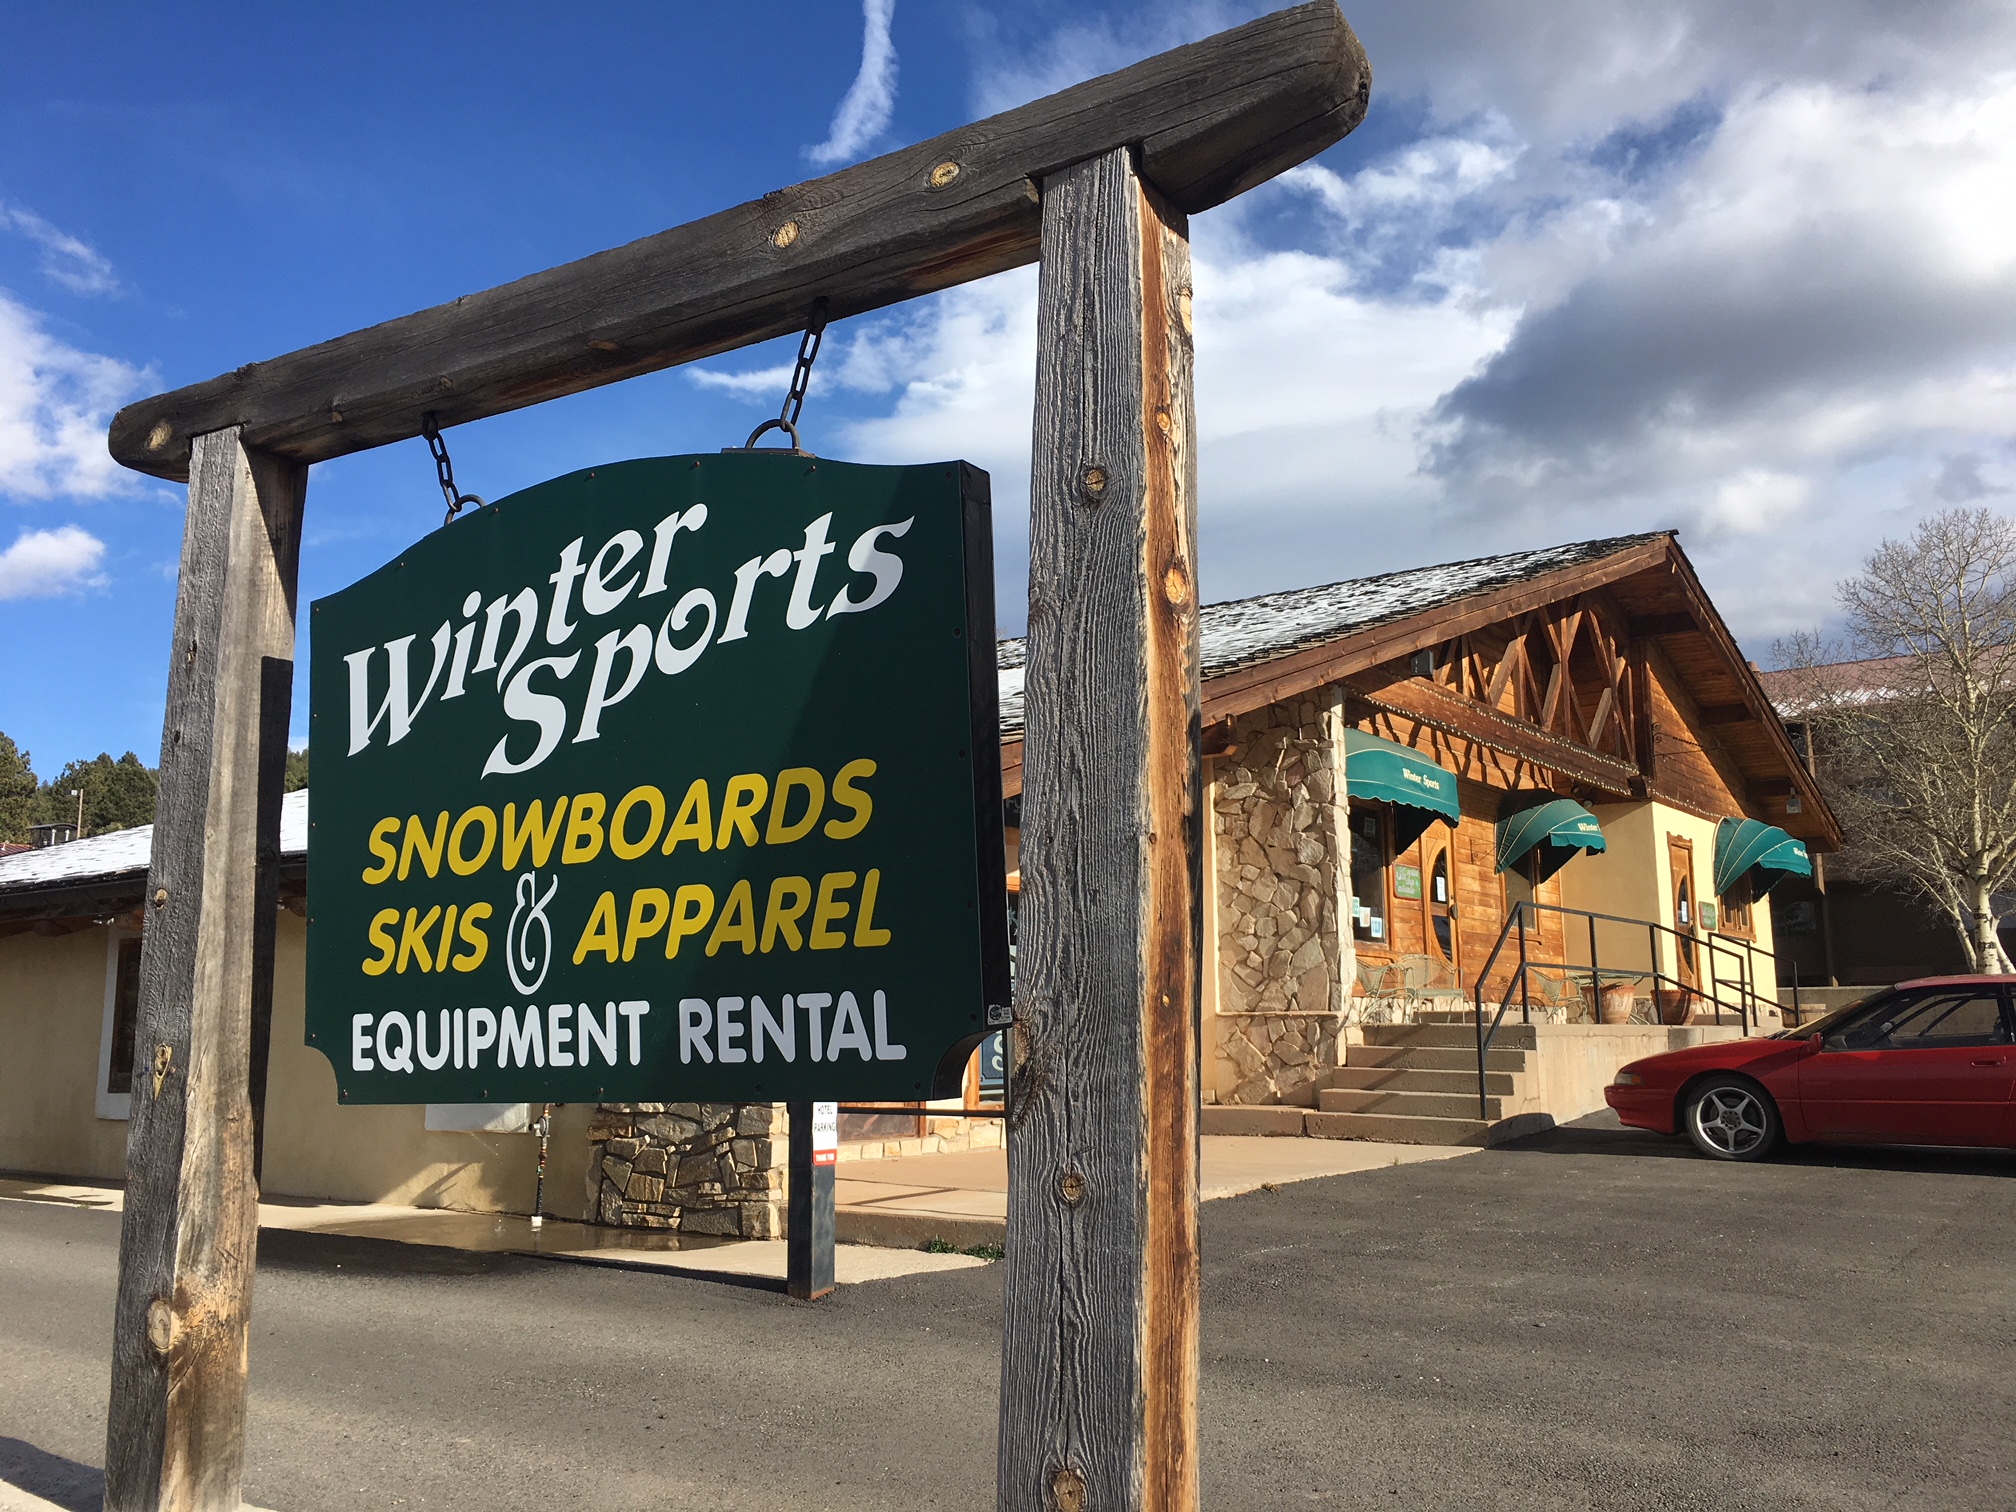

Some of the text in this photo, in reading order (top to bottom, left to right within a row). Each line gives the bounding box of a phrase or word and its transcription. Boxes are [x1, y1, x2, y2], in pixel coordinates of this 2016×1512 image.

[342, 503, 708, 757] Winter
[480, 511, 915, 780] Sports
[361, 758, 877, 885] SNOWBOARDS
[1402, 767, 1440, 790] Winter Sports
[361, 868, 892, 996] SKIS & APPAREL
[352, 1000, 651, 1074] EQUIPMENT
[678, 989, 907, 1065] RENTAL
[814, 1121, 836, 1132] PARKING
[817, 1104, 833, 1115] HOTEL
